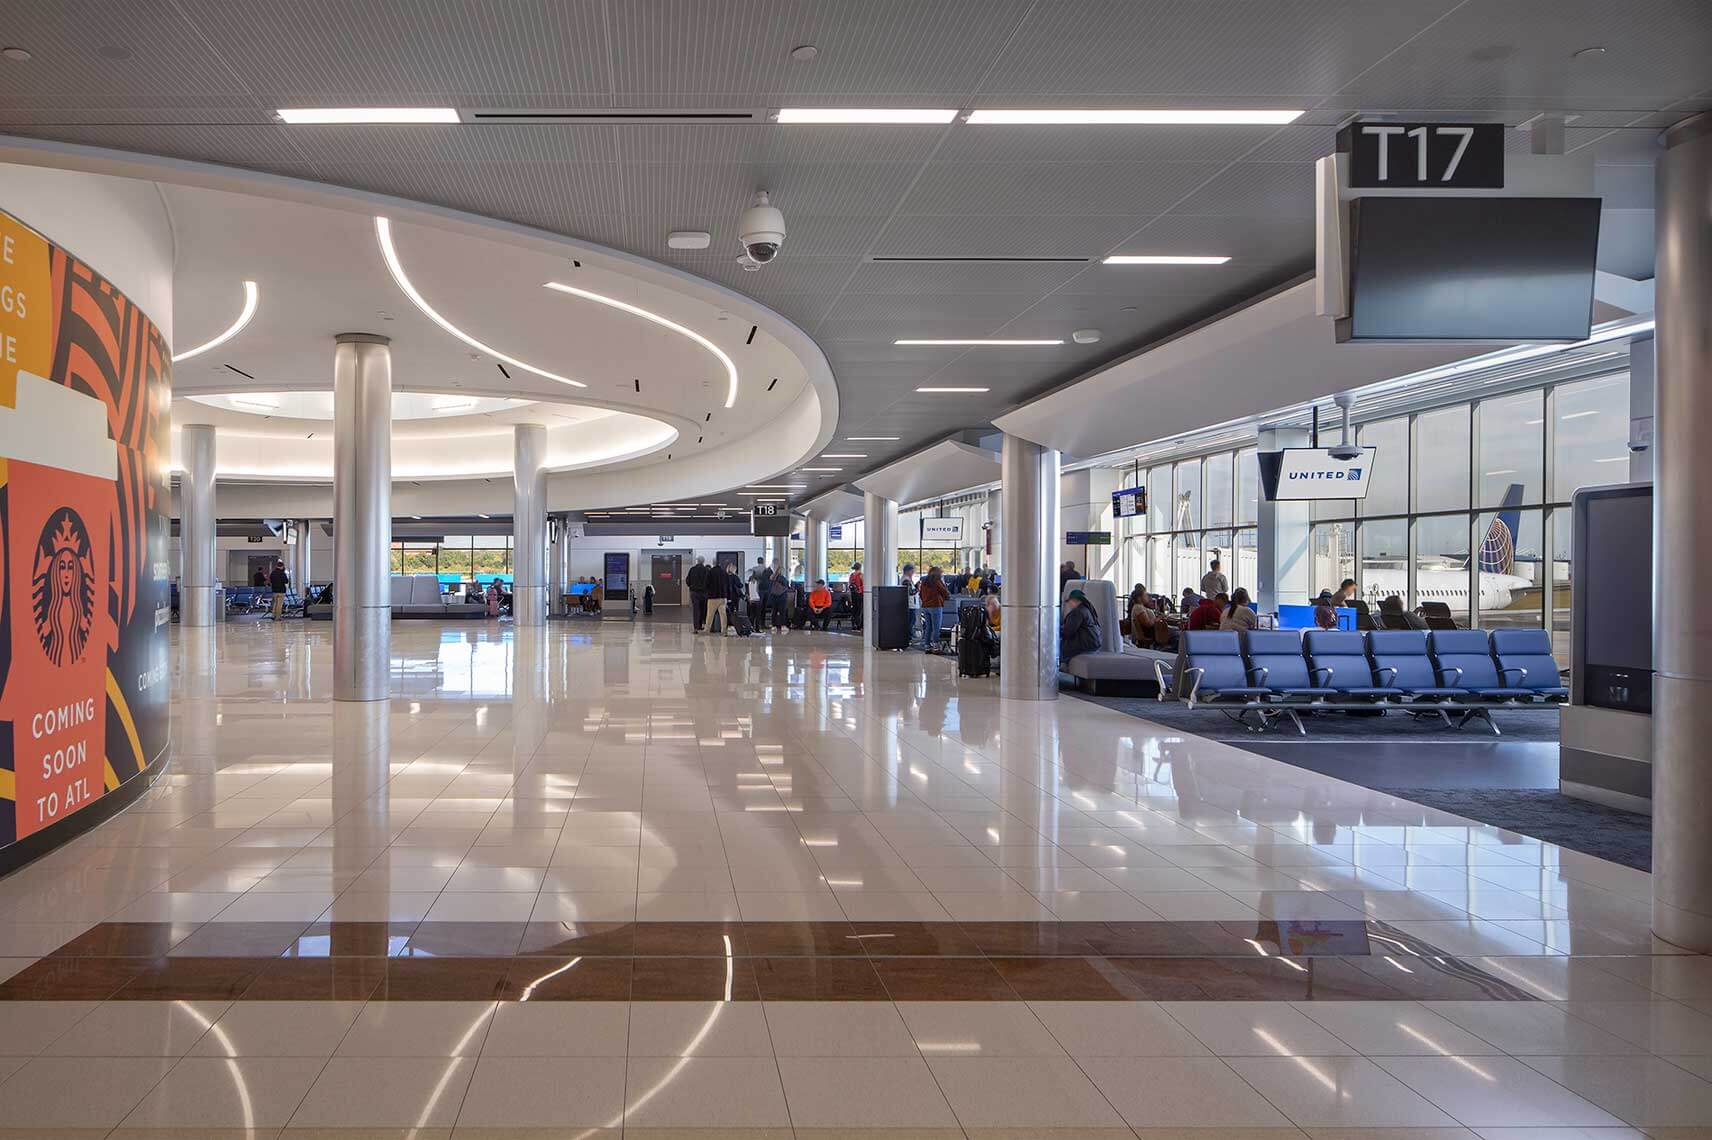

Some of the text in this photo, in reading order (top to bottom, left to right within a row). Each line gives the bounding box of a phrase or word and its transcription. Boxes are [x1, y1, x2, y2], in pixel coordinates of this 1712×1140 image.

[1361, 126, 1475, 182] T17
[1289, 471, 1345, 480] UNITED
[756, 505, 775, 515] T18
[32, 697, 95, 739] COMING
[43, 740, 87, 779] SOON
[37, 777, 91, 822] TO ATL
